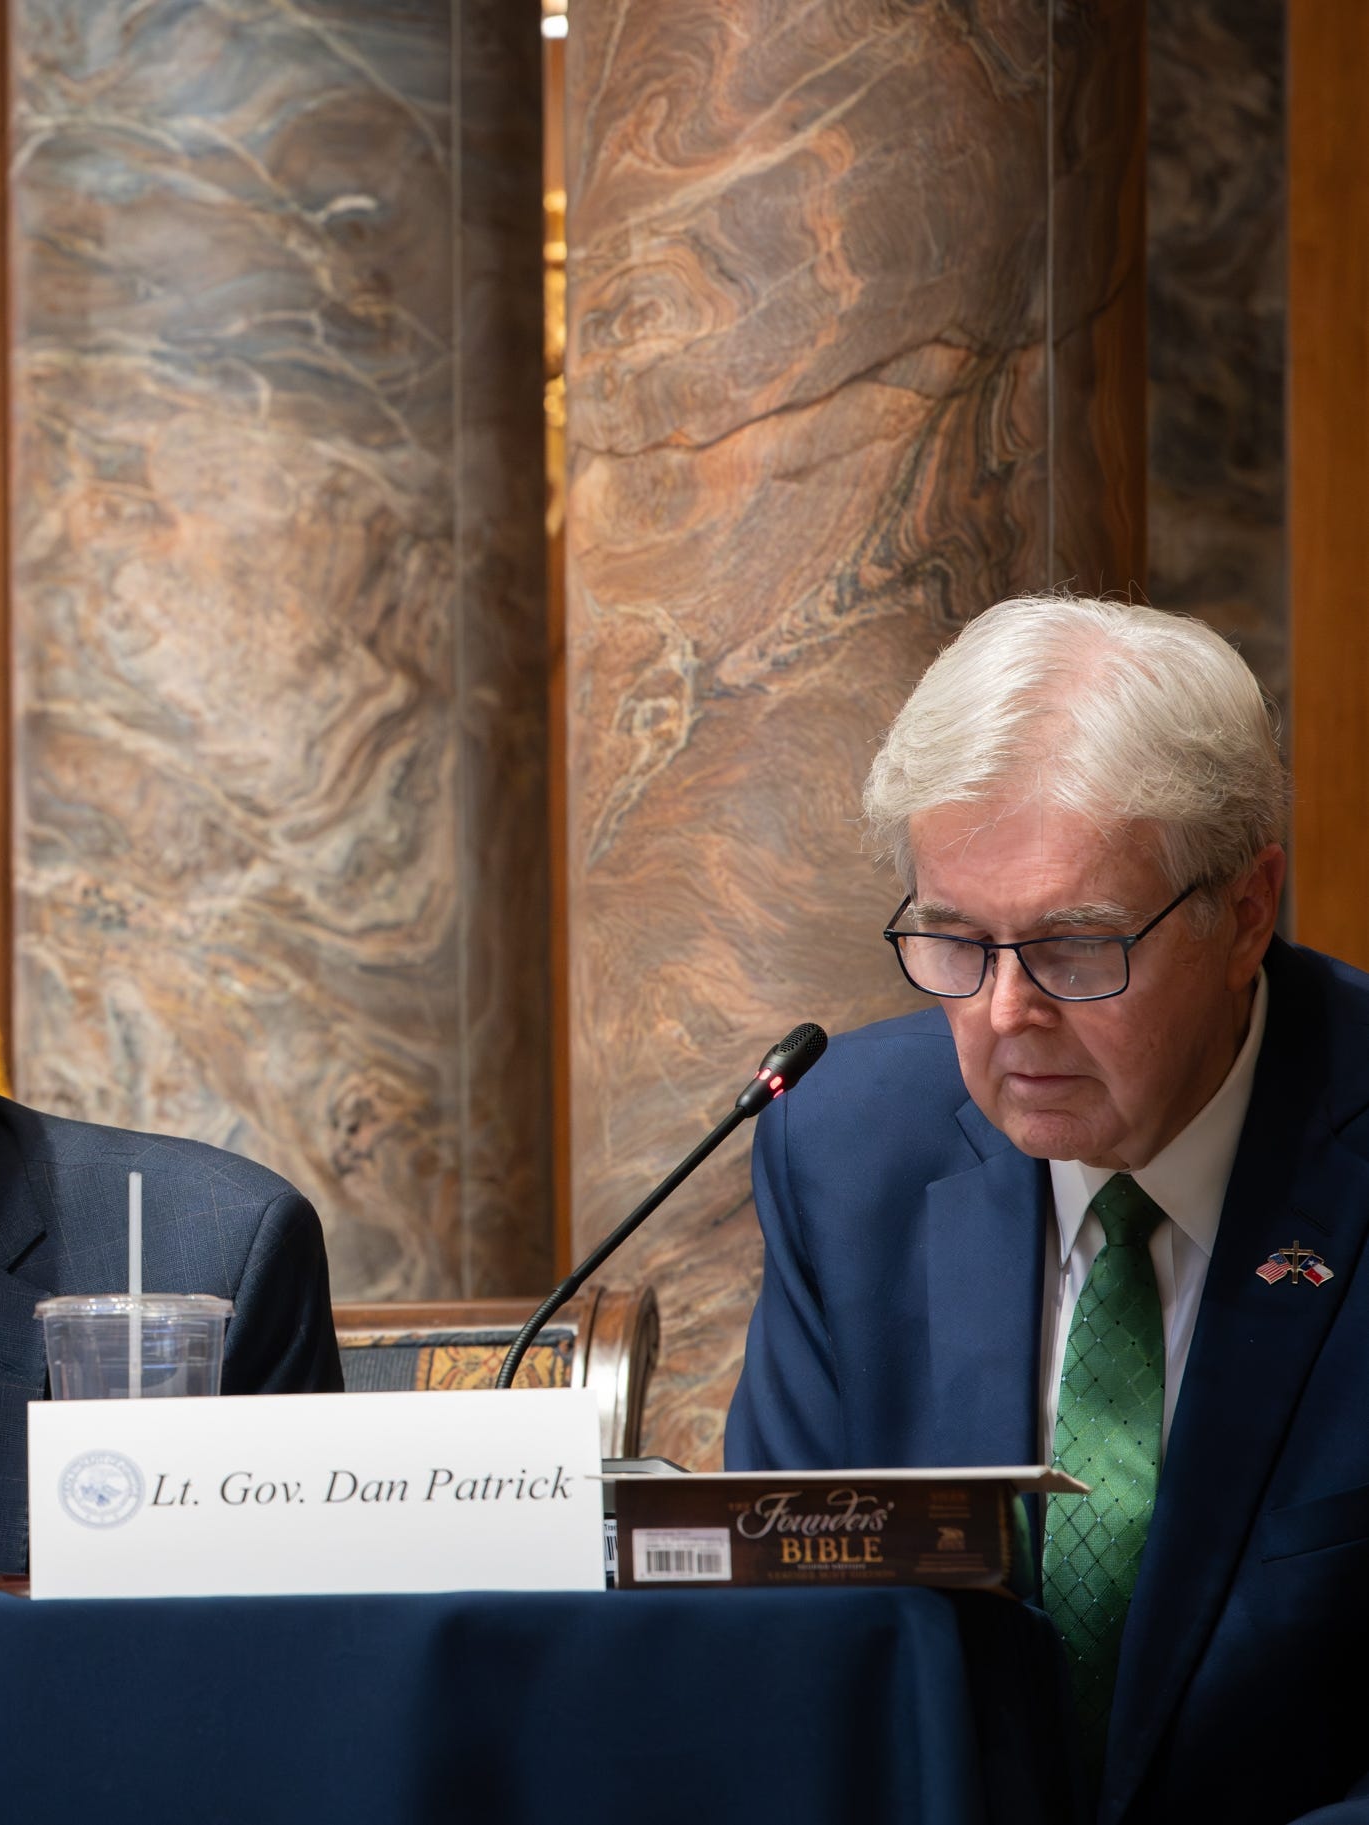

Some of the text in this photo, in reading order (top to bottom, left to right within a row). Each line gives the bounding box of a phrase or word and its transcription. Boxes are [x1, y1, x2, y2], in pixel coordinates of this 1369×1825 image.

[150, 1473, 200, 1507] Lt.
[219, 1470, 306, 1506] Gov.
[322, 1469, 408, 1504] Dan
[423, 1465, 575, 1502] Patrick
[736, 1488, 895, 1540] Founders'
[781, 1536, 884, 1564] BIBLE
